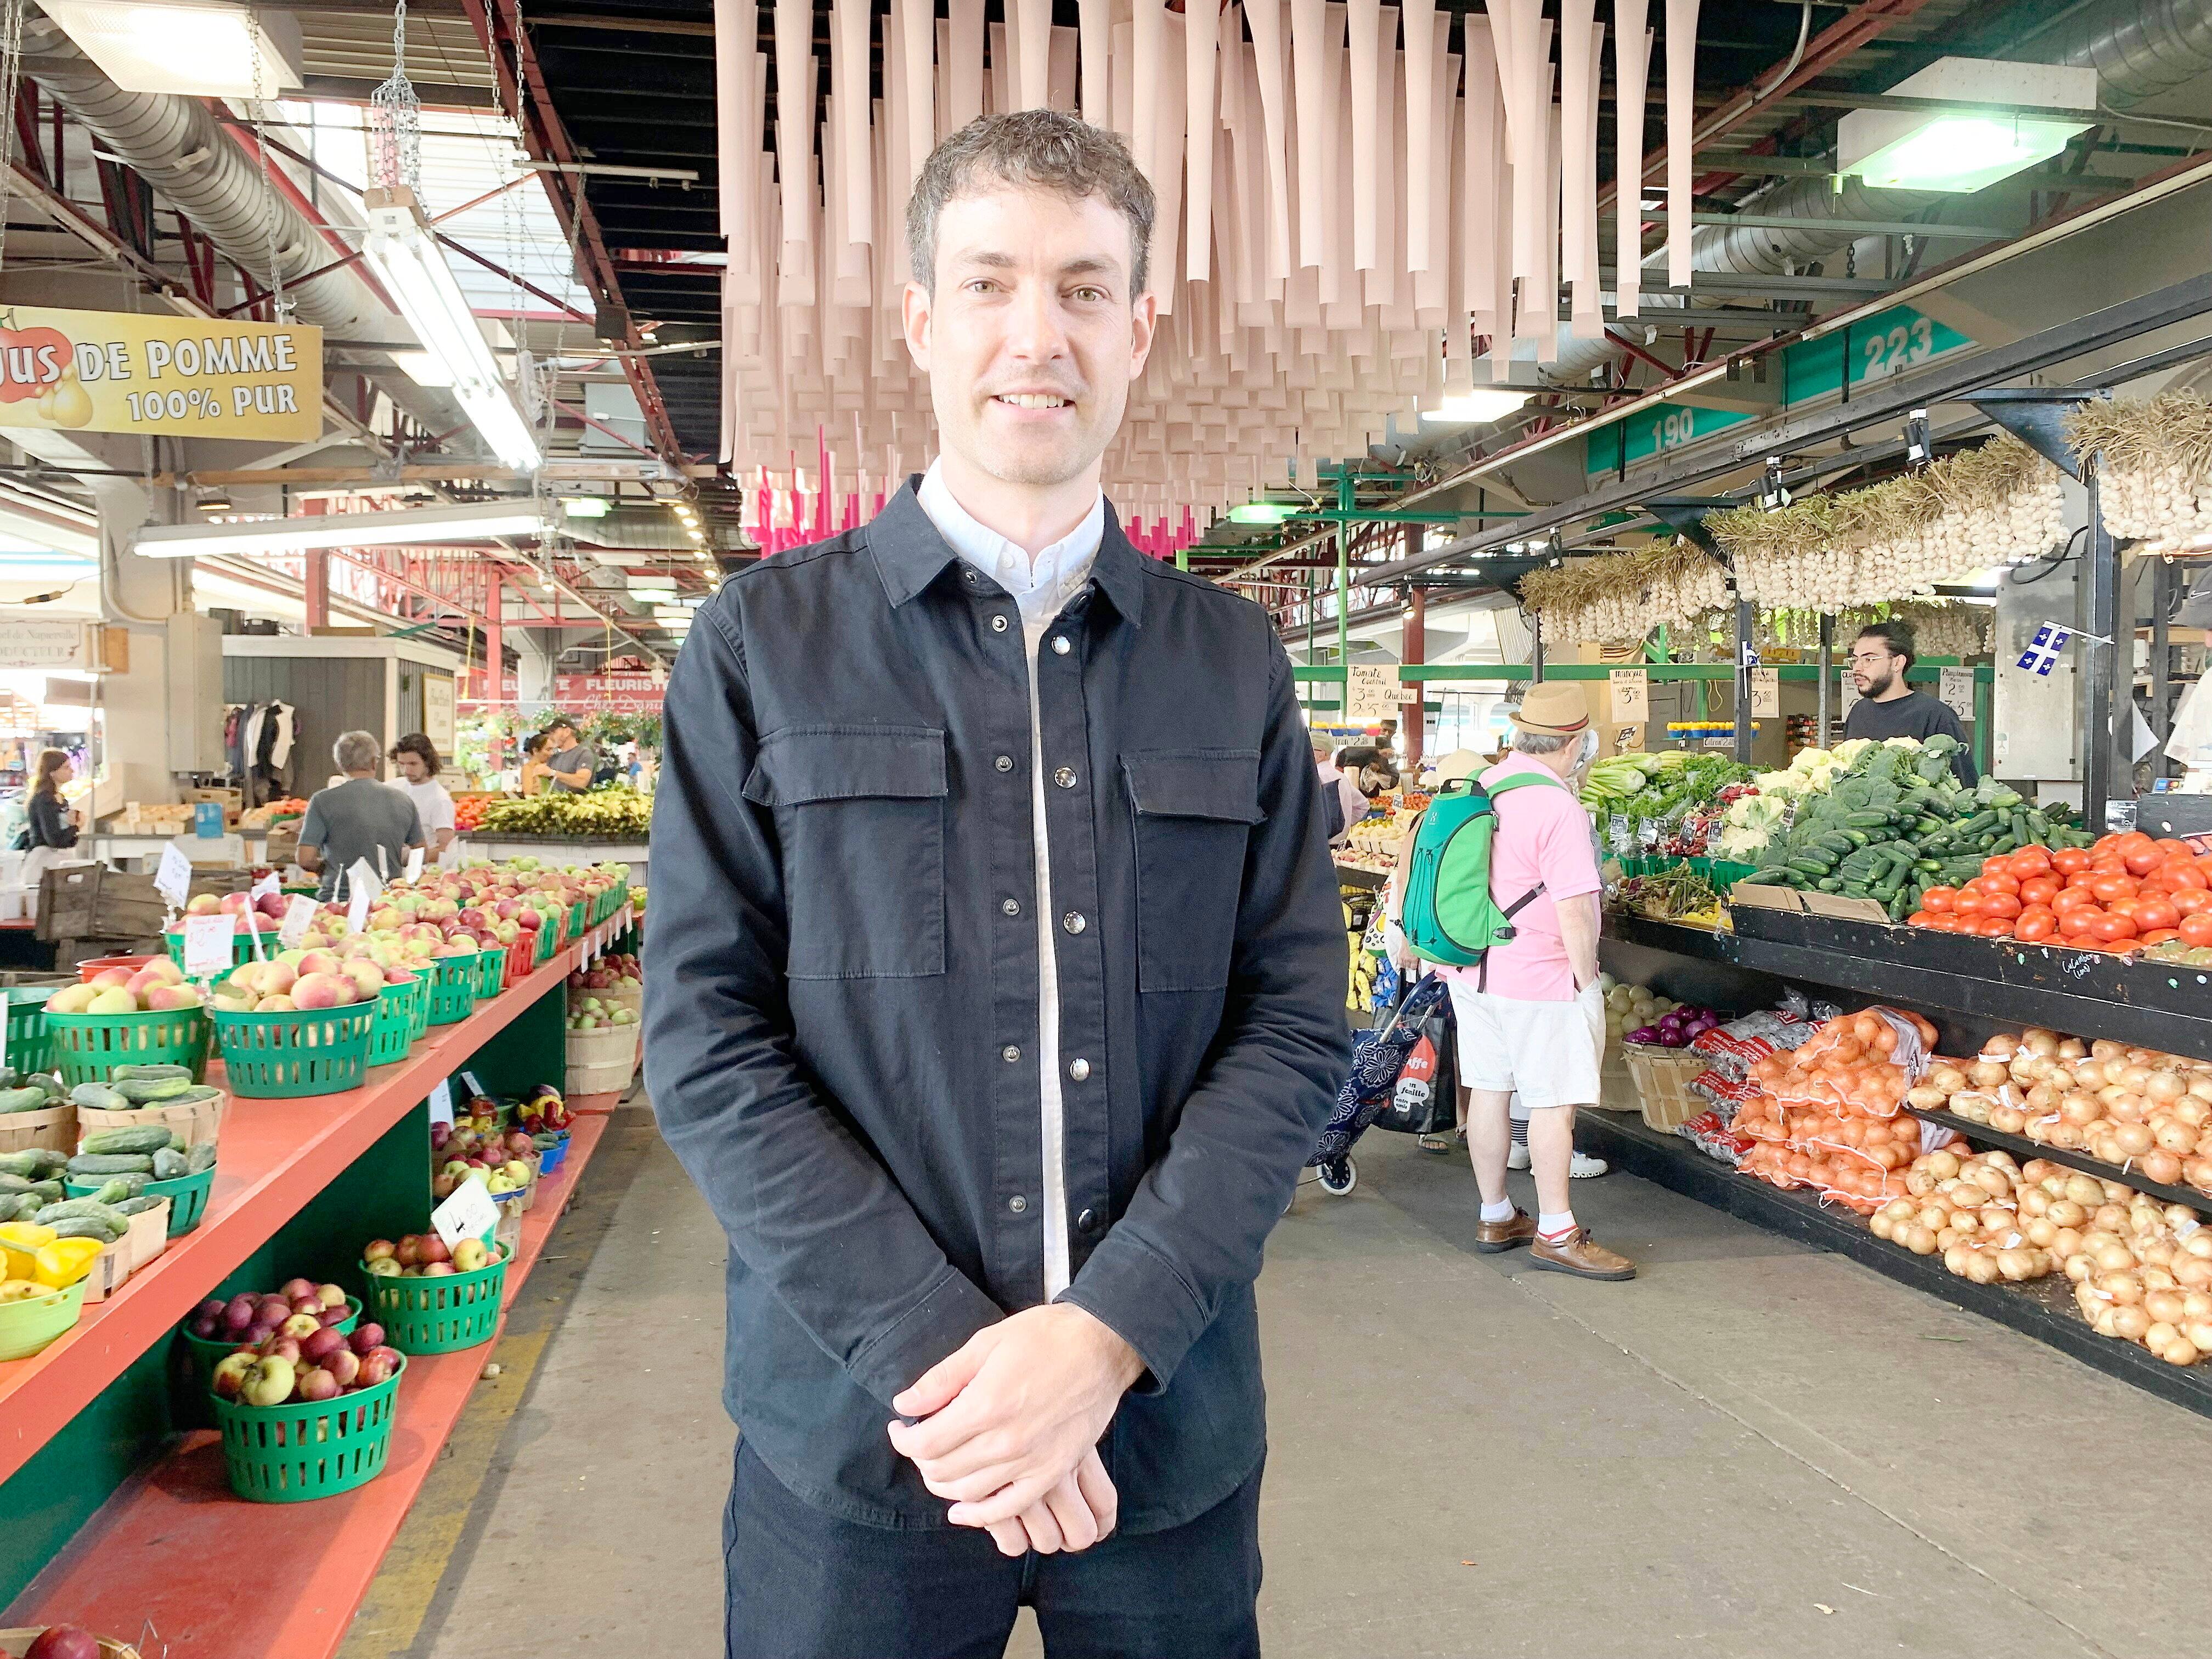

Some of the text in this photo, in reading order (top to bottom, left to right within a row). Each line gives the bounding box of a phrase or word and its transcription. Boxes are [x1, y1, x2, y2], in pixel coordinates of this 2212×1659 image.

[75, 342, 132, 381] DE
[145, 334, 297, 379] POMME
[1864, 318, 1932, 380] 223
[126, 384, 299, 421] 100% PUR
[1652, 408, 1693, 453] 190
[0, 647, 64, 657] DUCTEUR
[1351, 666, 1381, 678] Tomate
[1401, 1087, 1425, 1097] famille
